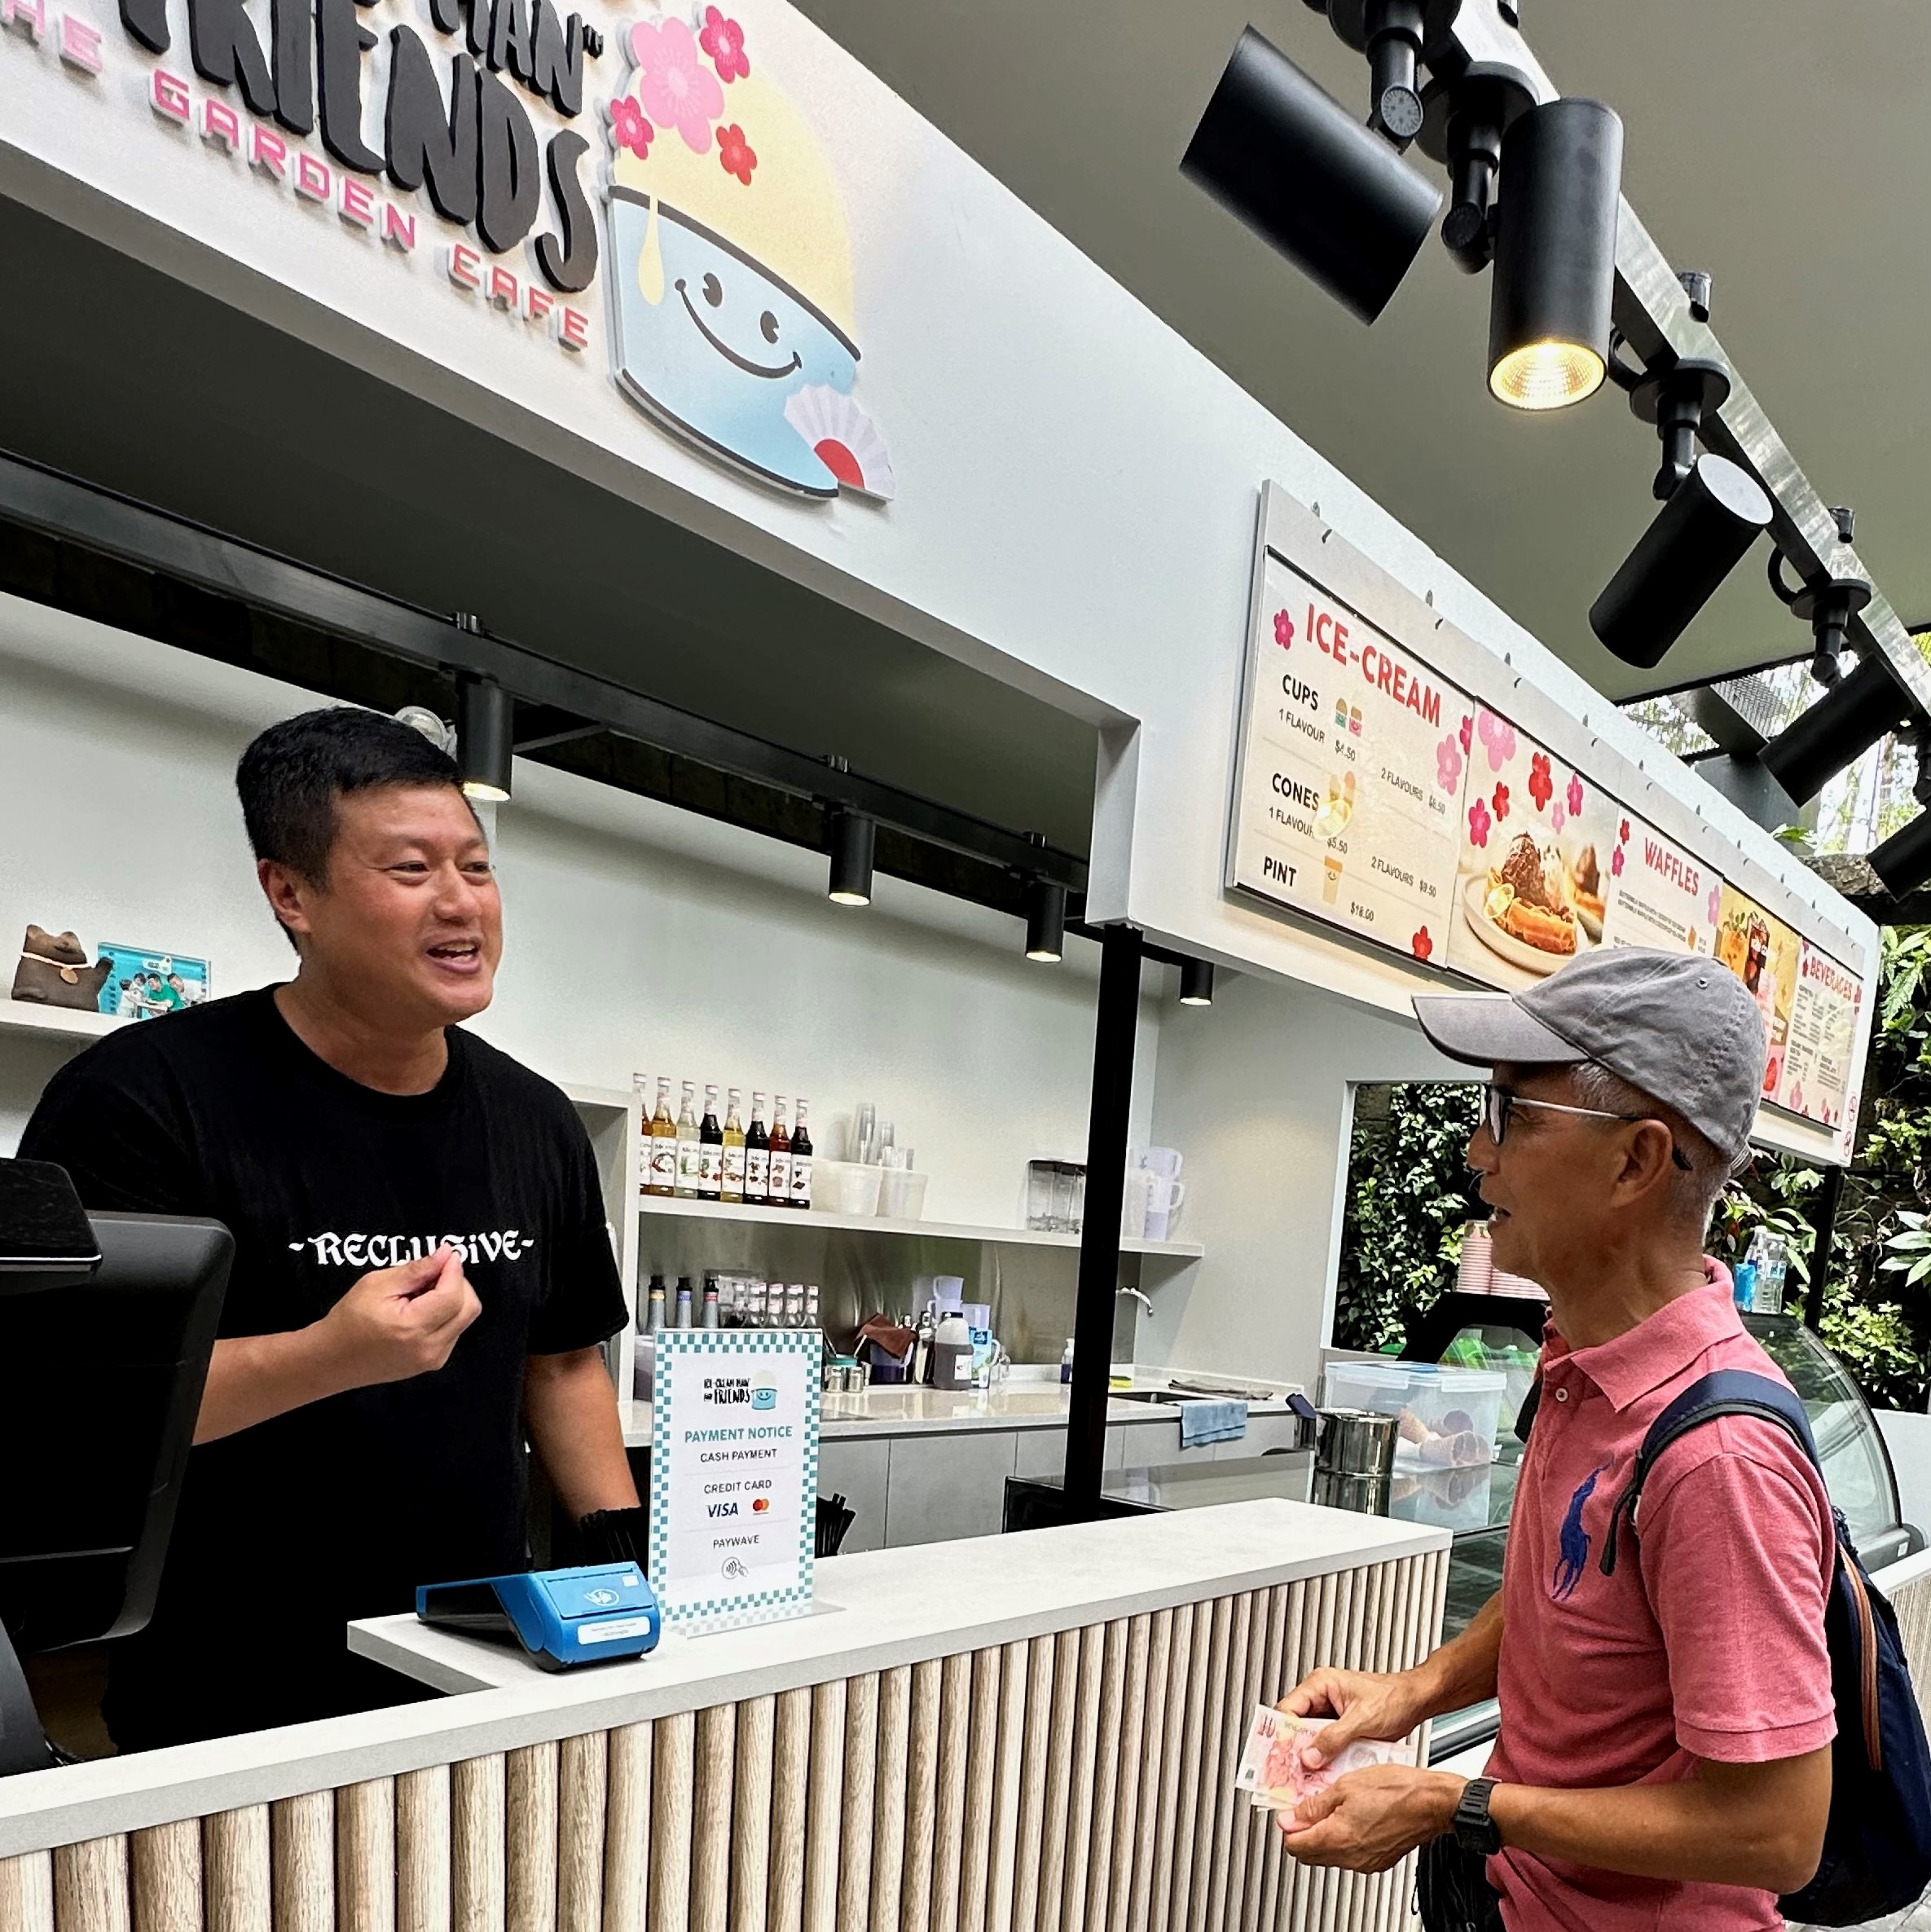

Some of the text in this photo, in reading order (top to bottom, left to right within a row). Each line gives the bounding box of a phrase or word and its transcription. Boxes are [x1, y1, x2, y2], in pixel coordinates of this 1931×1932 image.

[150, 67, 417, 254] GARDEN
[450, 243, 590, 350] CAFE
[1305, 602, 1441, 728] ICE-CREAM
[1282, 673, 1318, 711] CUPS
[1279, 708, 1285, 721] 1
[1285, 710, 1326, 745] FLAVOUR
[1381, 767, 1387, 780] 2
[1387, 771, 1423, 802] FLAVOURS
[1272, 772, 1319, 812] CONES
[1269, 806, 1273, 819] 1
[1326, 836, 1348, 855] $5.50
[1370, 856, 1377, 869] 2
[1377, 858, 1414, 887] FLAVOURS
[1643, 836, 1699, 896] WAFFLES
[1263, 856, 1297, 888] PINT
[1809, 956, 1854, 1000] BEVERAGES
[684, 1425, 794, 1444] PAYMENT NOTICE
[700, 1448, 777, 1463] CASH PAYMENT
[703, 1479, 772, 1494] CREDIT CARD
[706, 1502, 739, 1518] VISA
[712, 1534, 760, 1550] PAYWAVE
